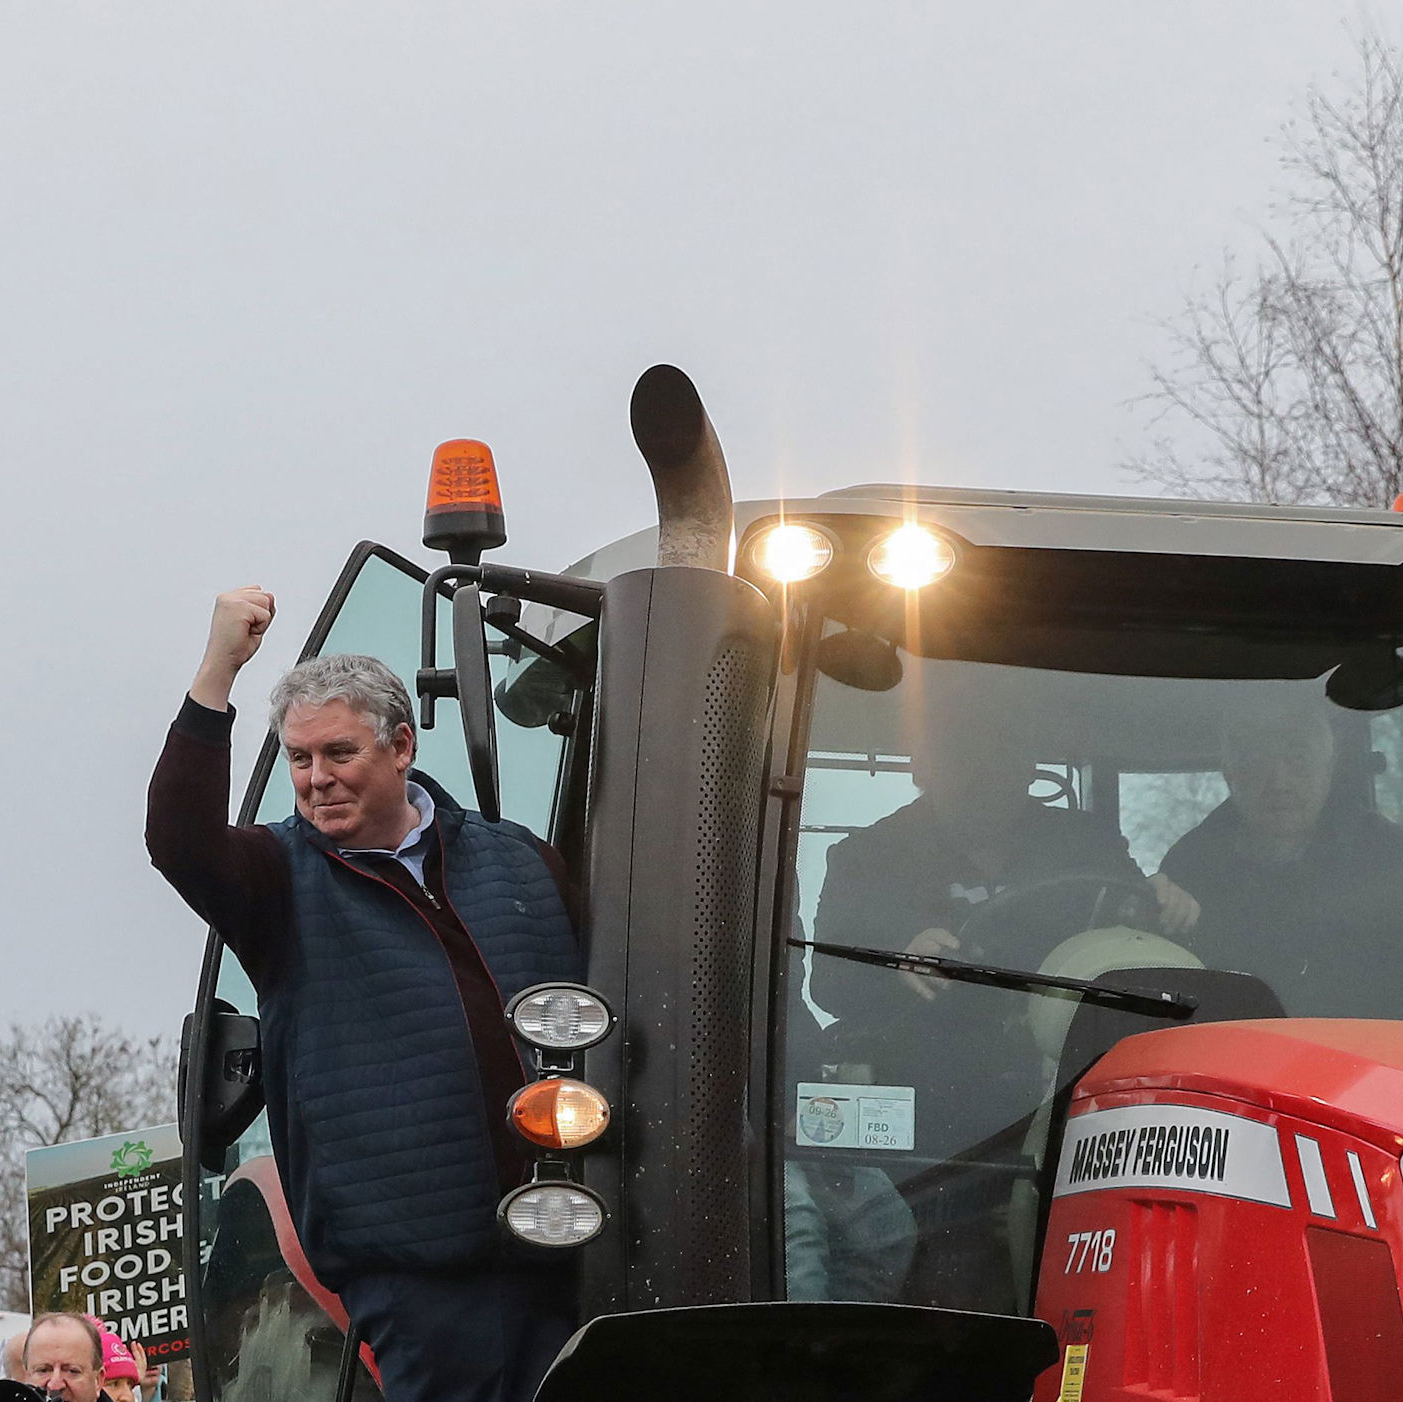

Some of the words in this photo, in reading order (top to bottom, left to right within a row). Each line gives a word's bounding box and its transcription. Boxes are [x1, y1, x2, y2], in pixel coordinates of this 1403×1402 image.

[808, 1105, 837, 1119] 09-26
[868, 1122, 889, 1132] FBD
[865, 1135, 897, 1146] 08-26
[1069, 1128, 1137, 1184] MASSEY
[1133, 1125, 1230, 1182] FERGUSON
[84, 1212, 184, 1257] IRISH
[1064, 1229, 1116, 1274] 7718
[60, 1248, 172, 1293] FOOD
[87, 1274, 186, 1316] IRISH
